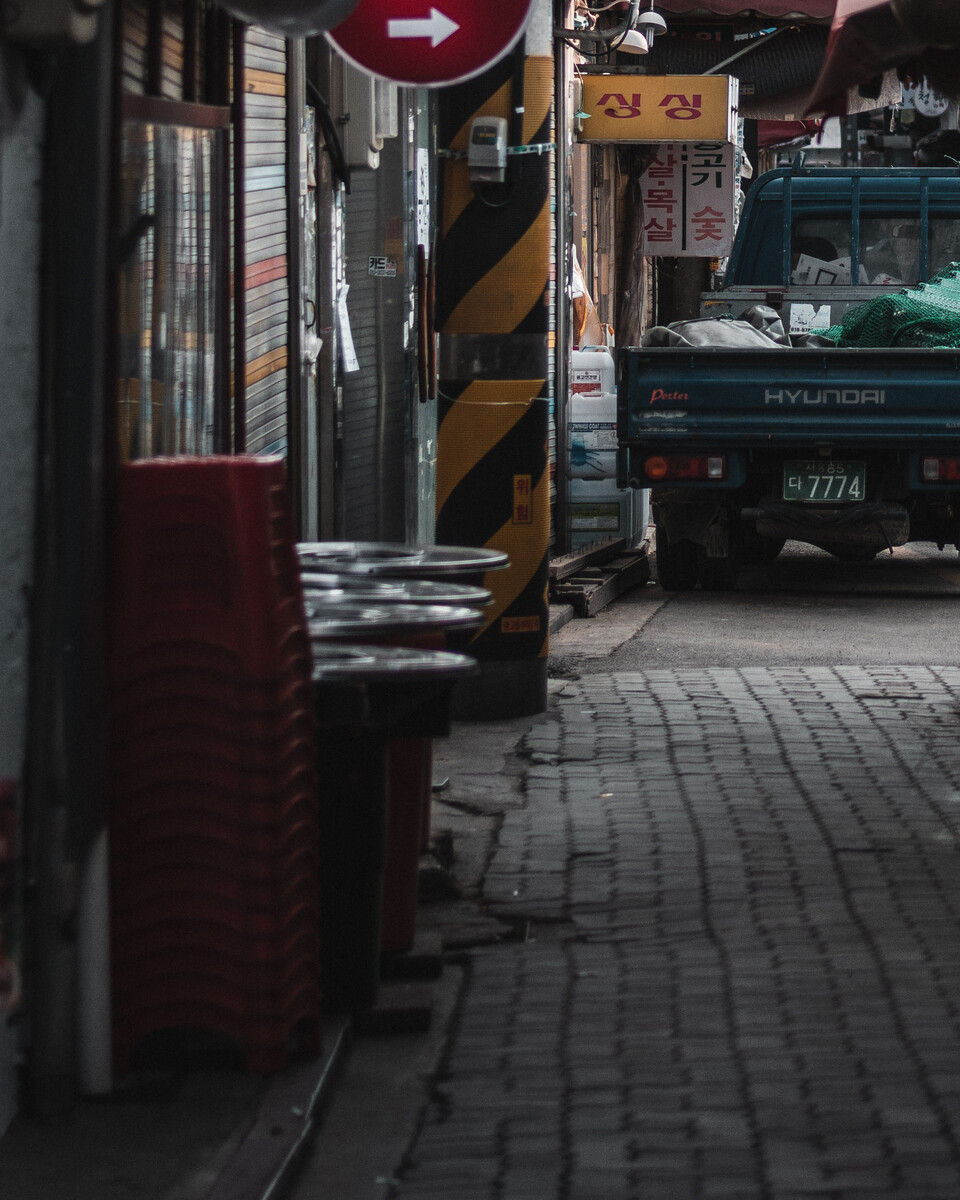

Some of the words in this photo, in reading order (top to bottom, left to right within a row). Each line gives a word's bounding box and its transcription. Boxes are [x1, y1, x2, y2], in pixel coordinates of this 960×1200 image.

[690, 205, 726, 242] 숯
[369, 257, 386, 270] 카드
[649, 388, 689, 406] Porter
[764, 389, 886, 405] HYUNDAI
[826, 463, 845, 474] 85
[788, 476, 801, 491] 다
[808, 475, 861, 499] 7774
